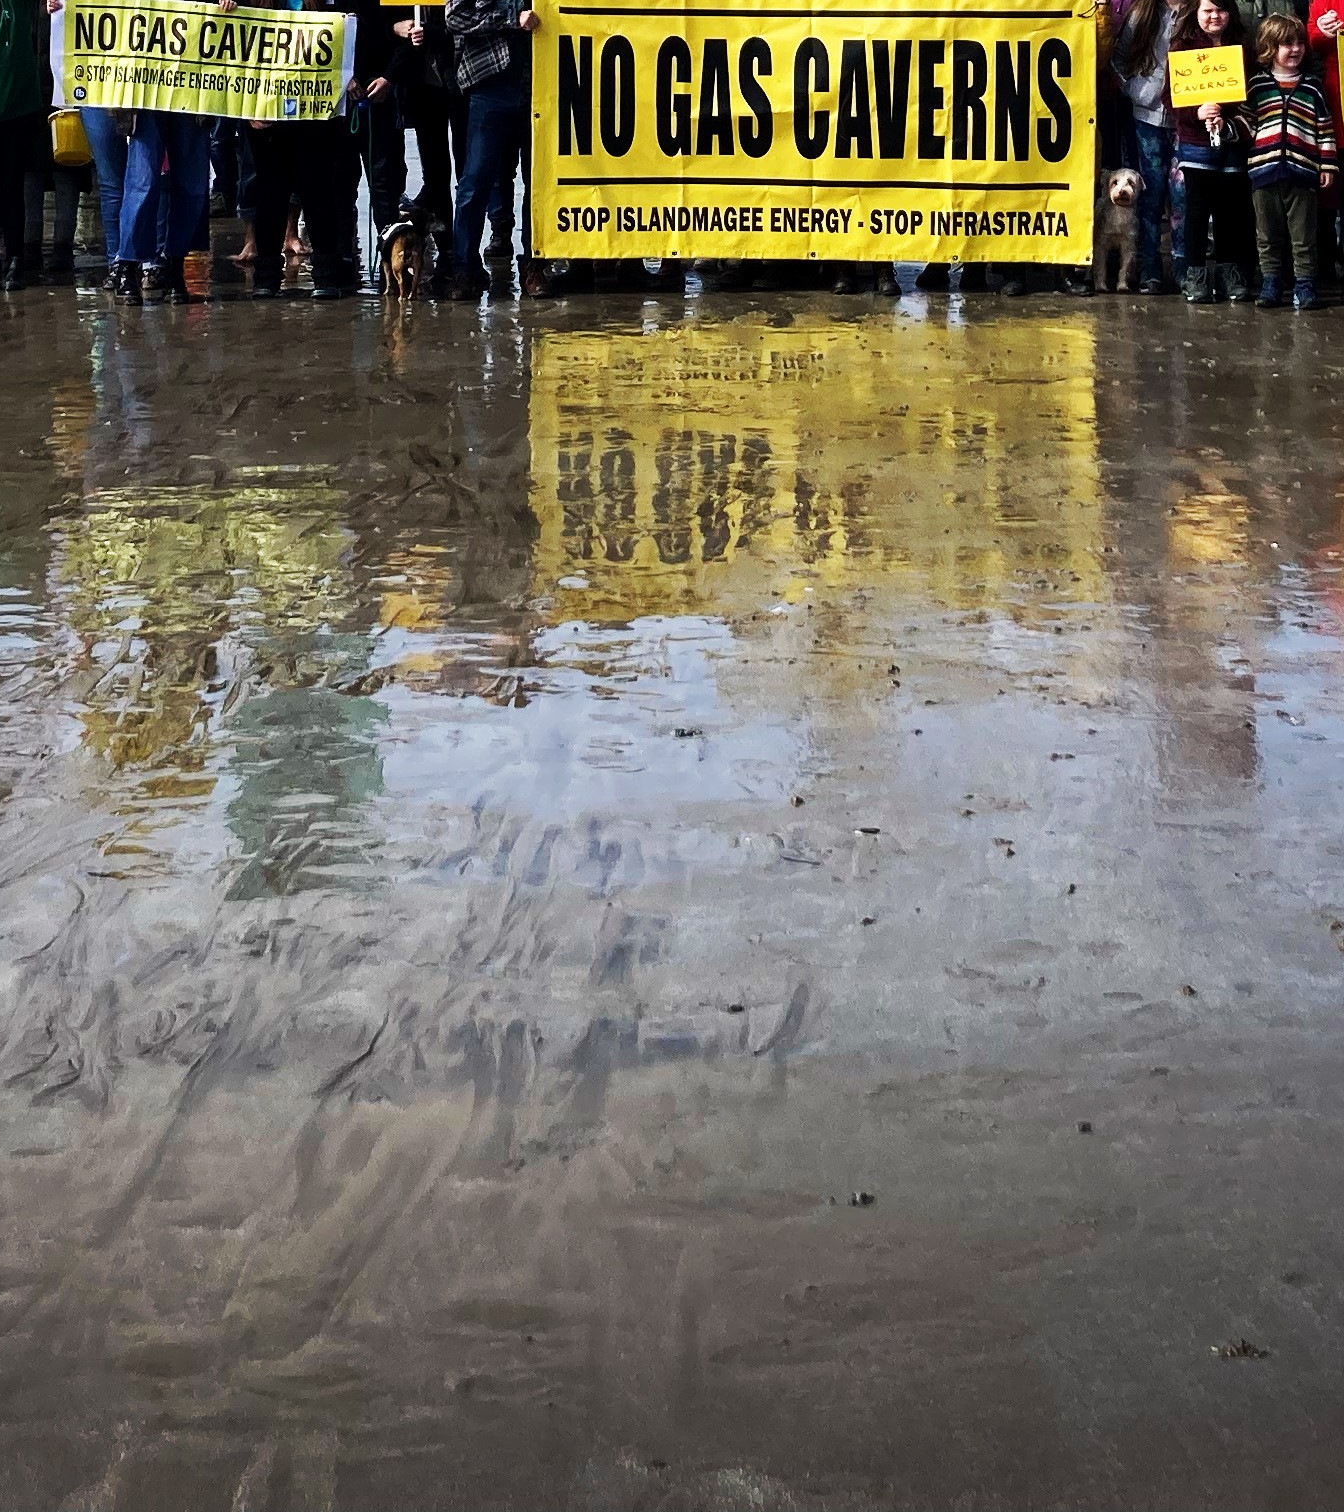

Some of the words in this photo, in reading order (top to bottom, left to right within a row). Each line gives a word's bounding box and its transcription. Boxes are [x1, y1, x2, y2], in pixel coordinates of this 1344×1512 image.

[75, 12, 116, 51] NO
[128, 13, 187, 56] GAS
[198, 21, 333, 67] CAVERNS
[74, 65, 84, 81] @
[87, 65, 111, 82] STOP
[115, 66, 186, 88] ISLANDMAGEE
[1175, 69, 1192, 77] NO
[1202, 64, 1227, 75] GAS
[558, 34, 636, 157] NO
[656, 35, 774, 159] GAS
[793, 36, 1072, 163] CAVERNS
[1173, 77, 1238, 94] CAVERNS
[557, 206, 610, 233] STOP
[616, 206, 764, 233] ISLANDMAGEE
[770, 207, 853, 234] ENERGY
[869, 209, 924, 236] STOP
[930, 210, 1069, 237] INFRASTRATA
